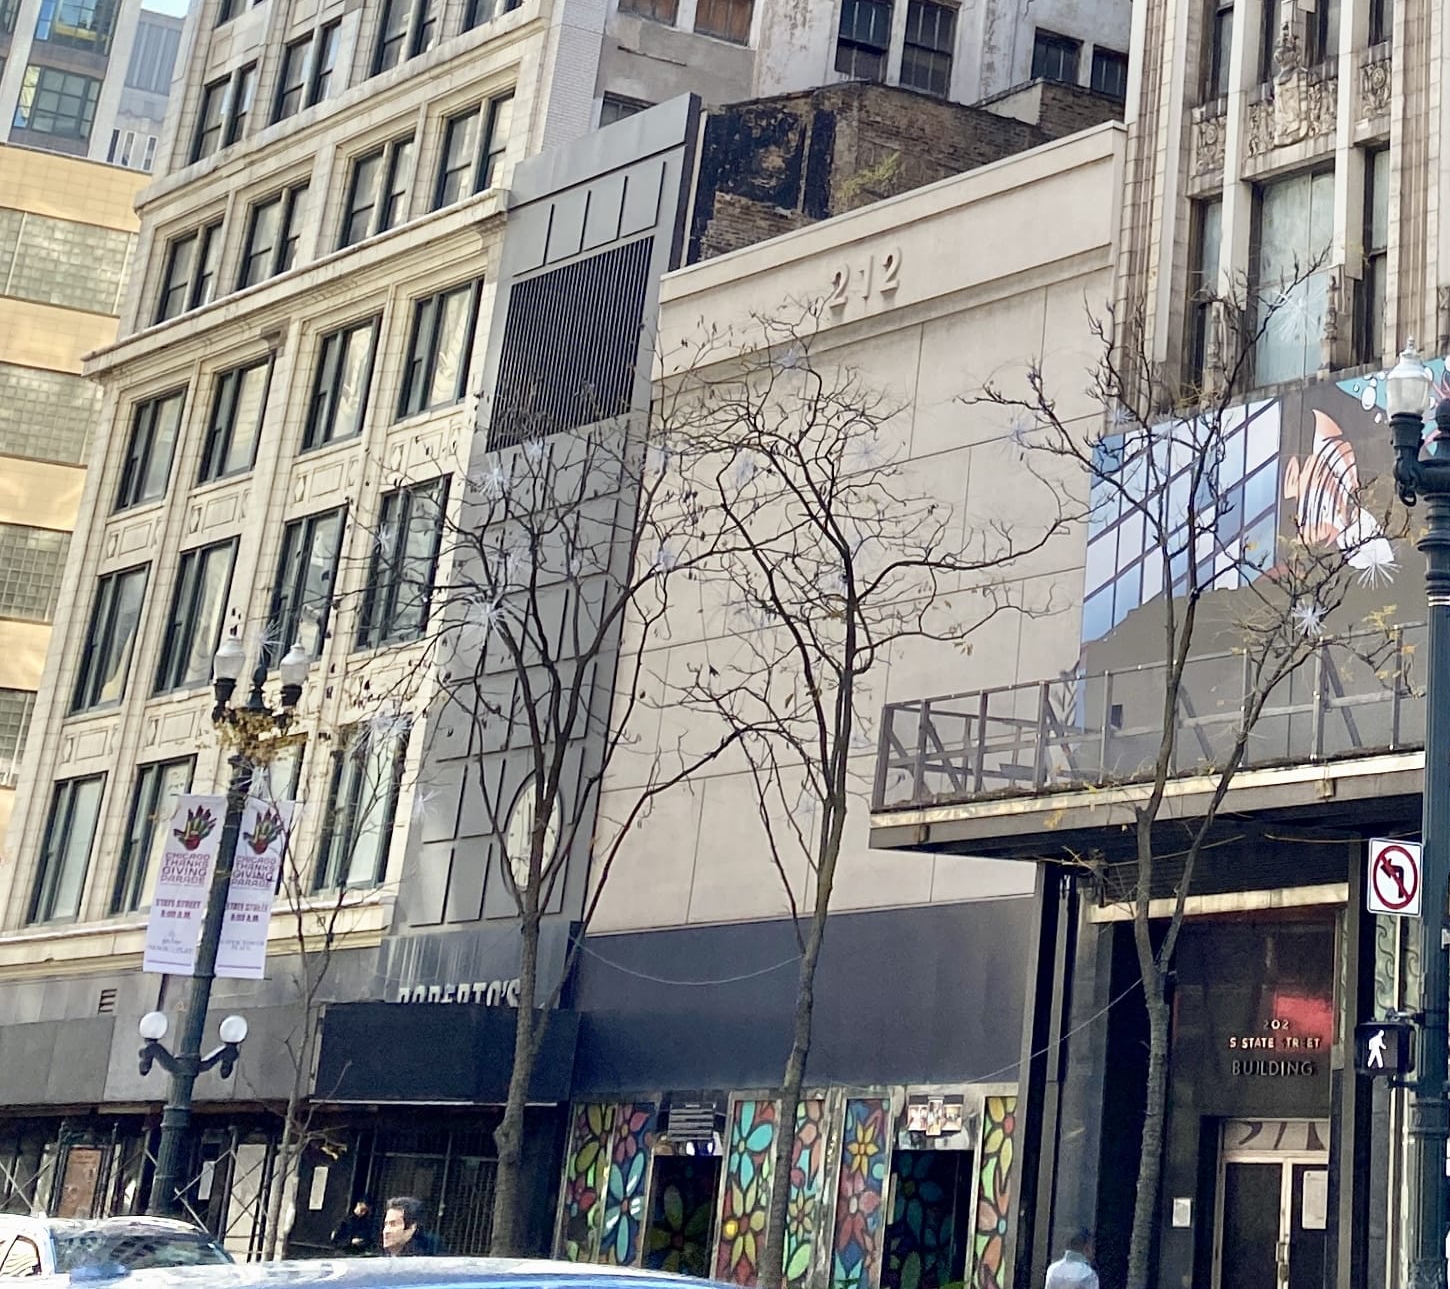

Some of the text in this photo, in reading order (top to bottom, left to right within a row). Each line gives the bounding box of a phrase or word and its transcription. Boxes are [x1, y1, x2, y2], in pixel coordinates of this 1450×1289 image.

[829, 246, 903, 310] 212
[1263, 1019, 1289, 1031] 202
[1242, 1037, 1275, 1049] STATE
[1283, 1037, 1320, 1048] TRET
[1232, 1061, 1313, 1076] BUILDING
